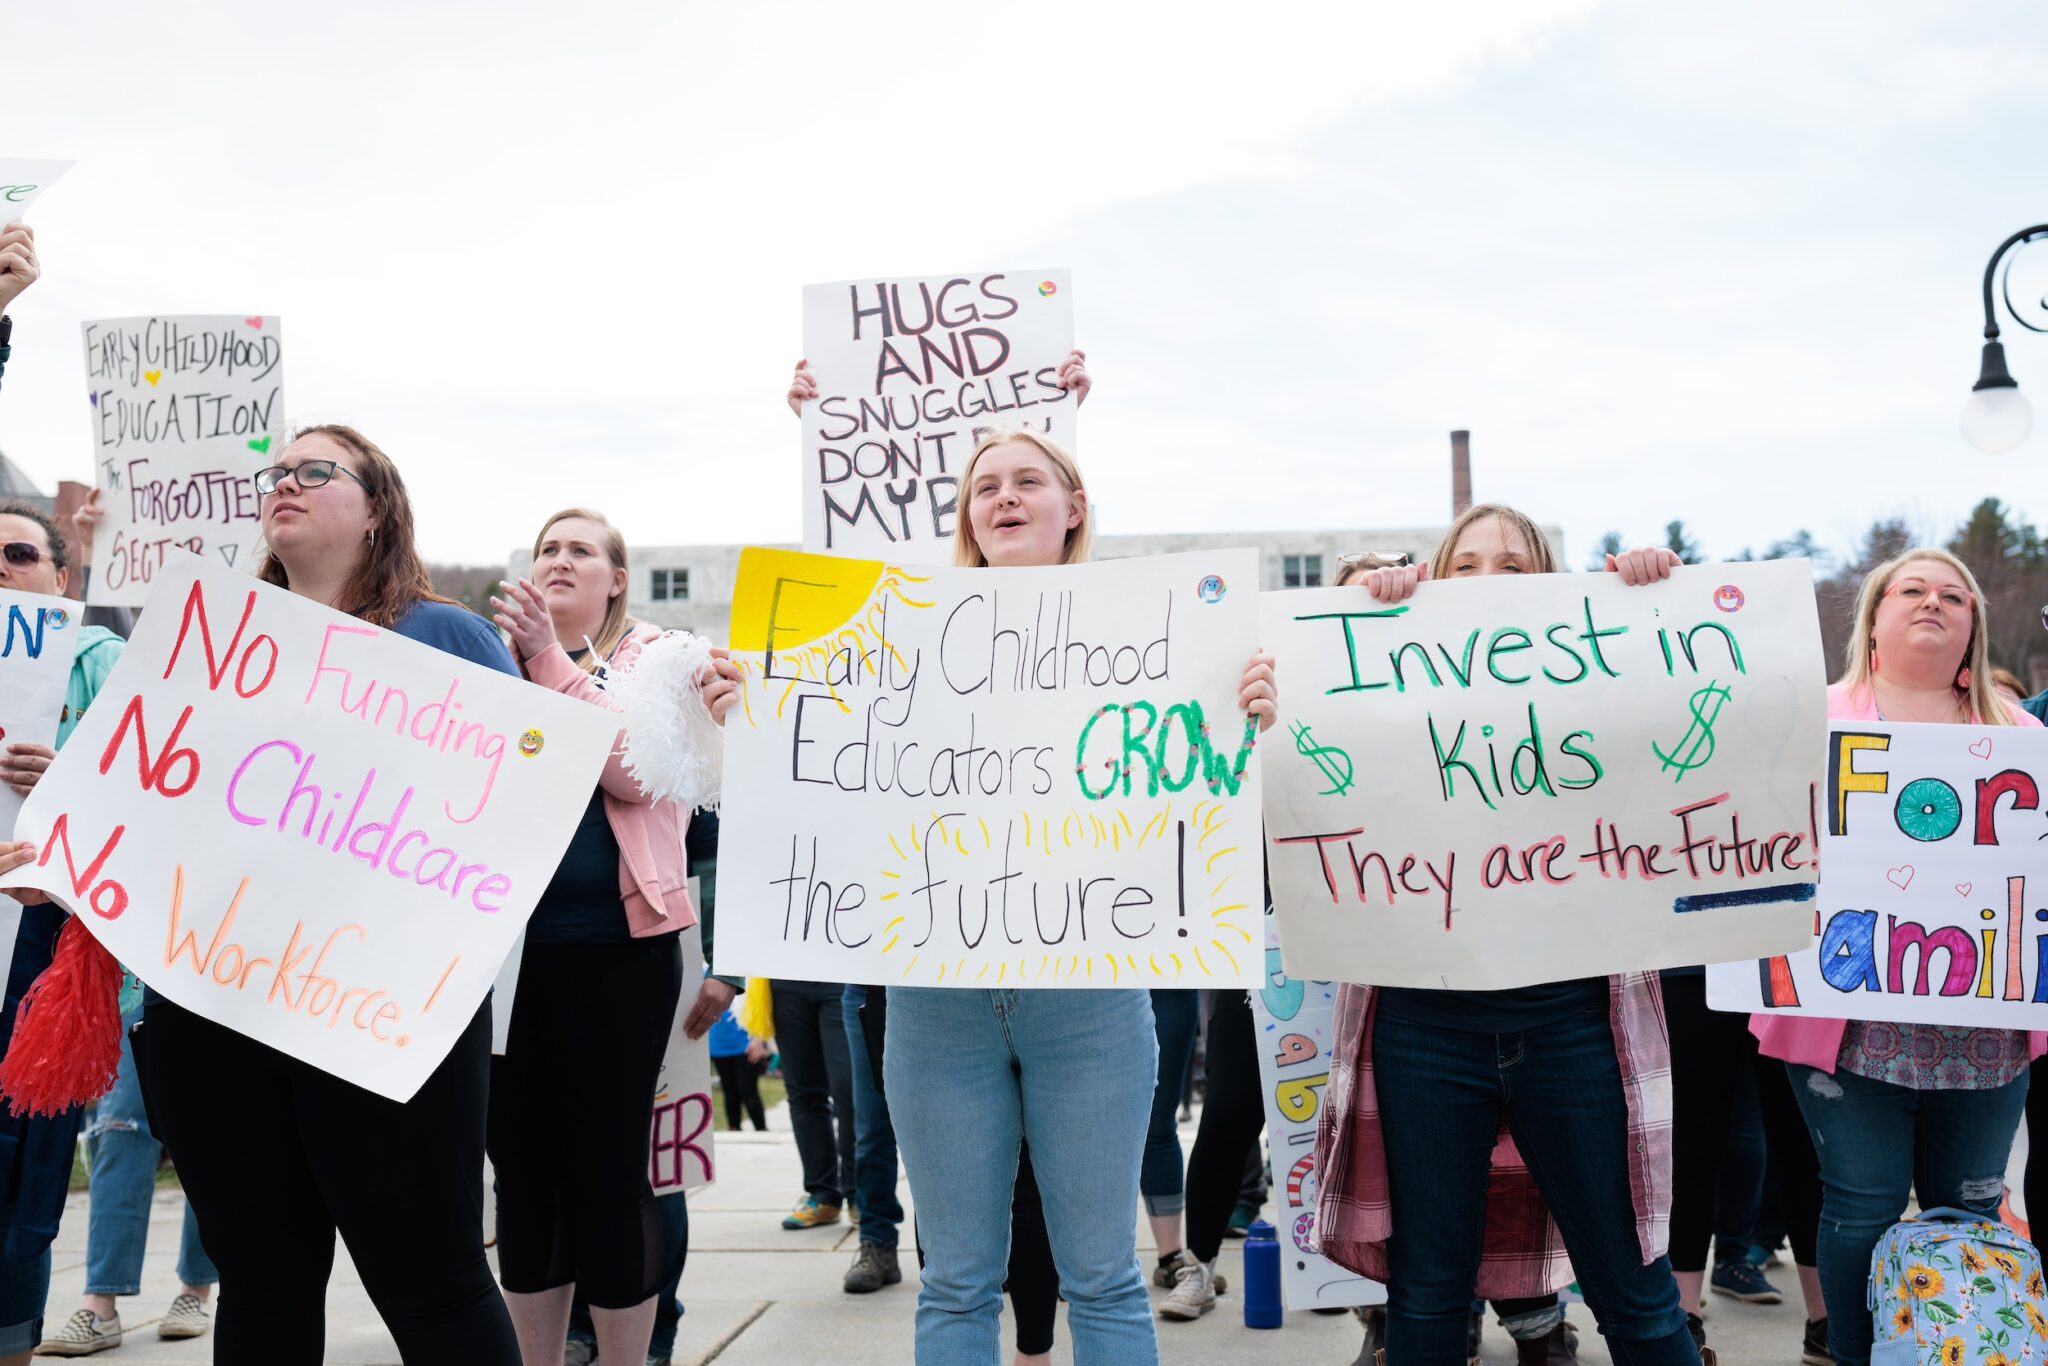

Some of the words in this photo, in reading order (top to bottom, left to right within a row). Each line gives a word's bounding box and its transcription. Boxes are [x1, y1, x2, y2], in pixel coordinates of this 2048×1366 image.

[86, 325, 139, 388] EARLY
[145, 318, 280, 382] CHILDHOOD
[850, 274, 1018, 340] HUGS
[819, 367, 1069, 440] SNUGGLES
[876, 327, 1010, 395] AND
[101, 387, 279, 448] EDUCATION
[818, 431, 956, 484] DON'T
[128, 459, 261, 526] FORGOTTE
[763, 578, 920, 726] Early
[940, 589, 1172, 695] Childhood
[1294, 597, 1629, 695] Invest
[1654, 608, 1746, 677] in
[163, 580, 279, 699] No
[305, 623, 507, 823] Funding
[793, 694, 1055, 797] Educators
[1075, 700, 1260, 800] GROW
[99, 694, 201, 798] No
[226, 739, 513, 914] Childcare
[1426, 701, 1604, 810] Kids
[38, 813, 128, 921] No
[770, 834, 873, 948] the
[911, 813, 1189, 949] future!
[1272, 827, 1457, 932] They
[1480, 834, 1577, 889] are
[1579, 817, 1677, 882] the
[1669, 781, 1820, 883] Future!
